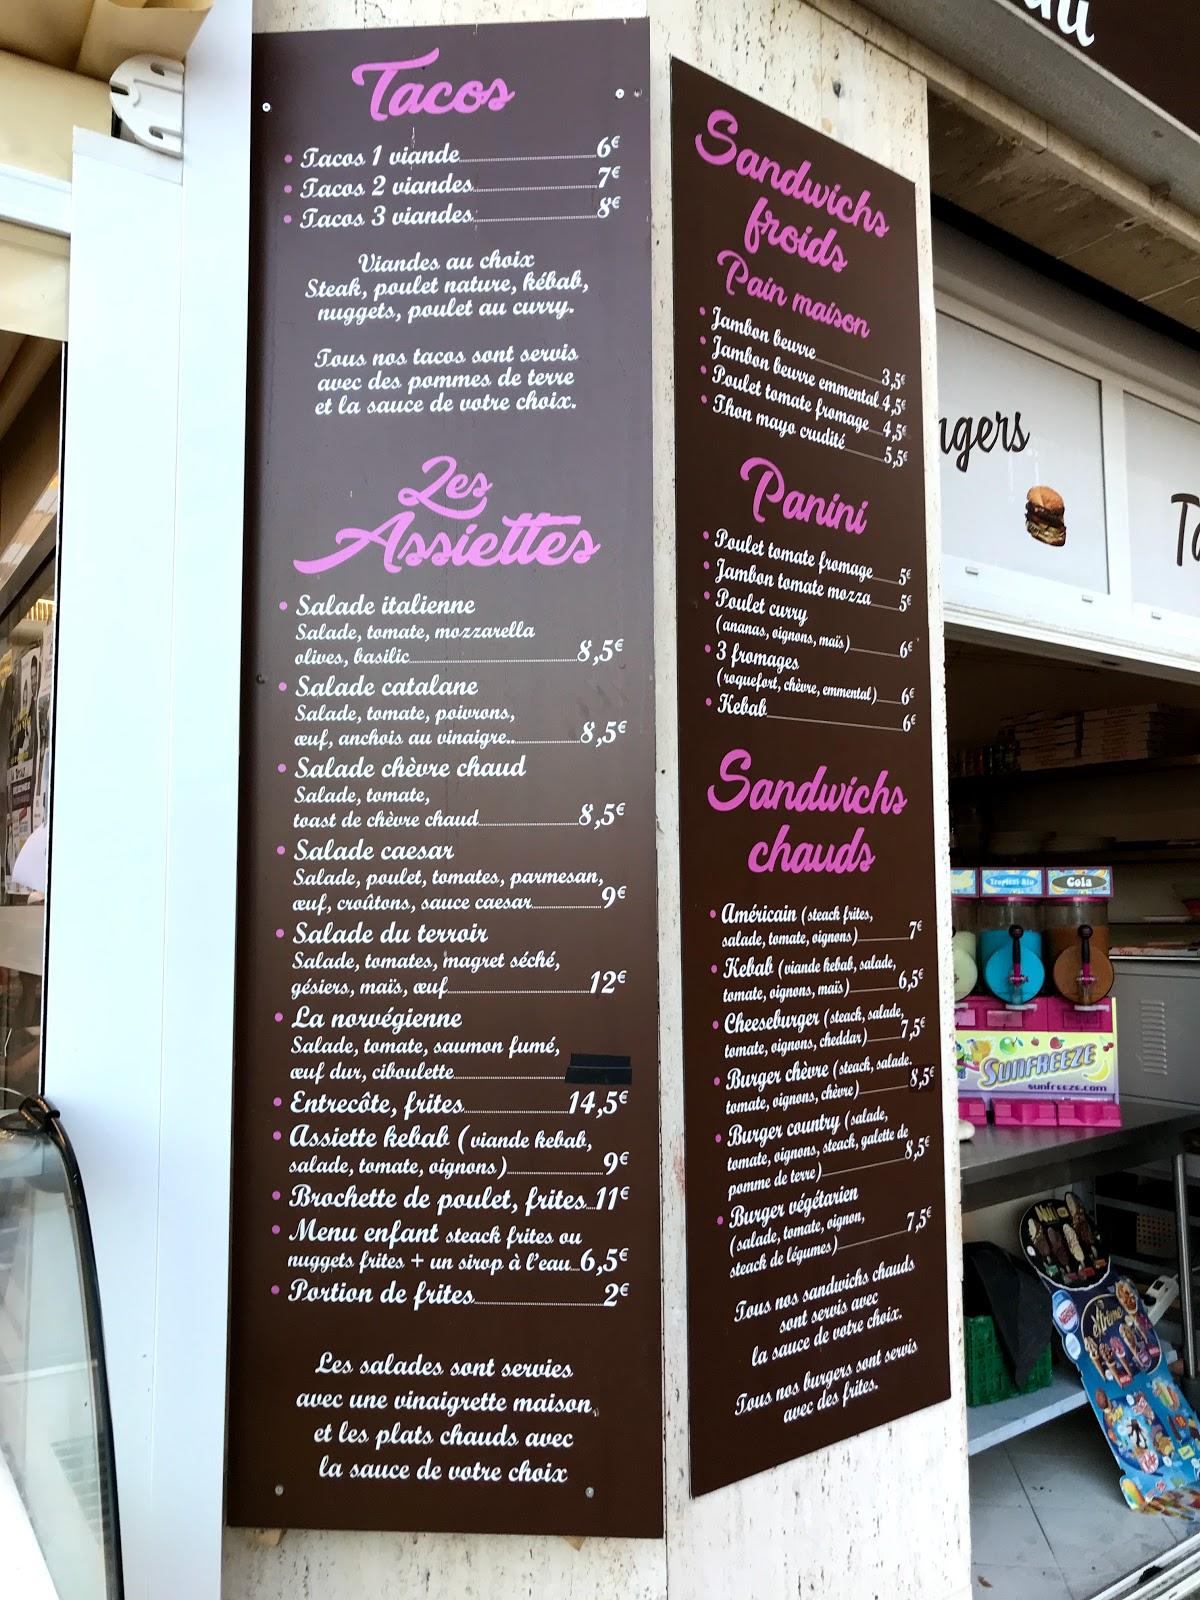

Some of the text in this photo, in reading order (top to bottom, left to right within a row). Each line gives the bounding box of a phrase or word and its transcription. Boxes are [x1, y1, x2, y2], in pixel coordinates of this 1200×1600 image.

[351, 48, 514, 121] Tacos
[300, 135, 621, 168] Tacos 1 viande 6€
[300, 165, 621, 198] Tacos 2 viandes 7€
[695, 110, 888, 236] Sandwichs
[299, 196, 621, 228] Tacos 3 viandes 8€
[744, 197, 848, 272] froids
[358, 248, 535, 273] Viandes au choix
[304, 269, 589, 301] Steak, poulet nature, kébab,
[717, 250, 869, 336] Pain maison
[317, 297, 574, 326] nuggets, poulet au curry.
[314, 343, 577, 368] Tous nos tacos sont servis
[710, 305, 906, 391] Jambon beurre 3,5€
[317, 366, 575, 394] avec des pommes de terre
[711, 334, 907, 416] Jambon beurre emmental 4,5€
[314, 389, 577, 415] et la sauce de votre choix.
[711, 364, 907, 442] Poulet tomate fromage 4,5€
[712, 393, 909, 468] Thon mayo crudité 5,5€
[399, 456, 491, 520] Les
[740, 457, 869, 533] Panini
[294, 511, 599, 573] Assiettes
[714, 527, 912, 585] Poulet tomate fromage 5€
[714, 557, 913, 612] Jambon tomate mozza 5€
[295, 592, 476, 616] Salade italienne
[714, 588, 808, 626] Poulet curry
[295, 620, 535, 642] Salade, tomate, mozzarella
[294, 638, 624, 667] olives, basilic 8,5€
[715, 639, 800, 674] 3 fromages
[295, 673, 479, 696] Salade catalane
[716, 693, 917, 732] Kebab 6€
[294, 754, 527, 778] Salade chèvre chaud
[707, 748, 908, 814] Sandwichs
[293, 802, 626, 830] toast de chèvre chaud 8,5€
[293, 838, 455, 861] Salade caesar
[747, 823, 875, 873] chauds
[1066, 876, 1093, 888] Cola
[292, 921, 489, 944] Salade du terroir
[721, 929, 766, 949] salade,
[768, 930, 810, 947] tomate,
[909, 919, 923, 940] 7€
[291, 978, 355, 1000] gésiers,
[360, 978, 408, 997] maïs,
[590, 970, 628, 993] 12€
[722, 986, 767, 1003] tomate,
[769, 984, 816, 1003] oignons,
[898, 967, 924, 992] 6,5€
[292, 1005, 463, 1035] La norvégienne
[329, 1061, 367, 1082] dur,
[371, 1061, 454, 1080] ciboulette
[982, 1043, 1097, 1087] SUNFREEZE
[1027, 1082, 1107, 1092] sunfreeze.com
[289, 1090, 629, 1120] Entrecôte, frites 14,5€
[288, 1183, 631, 1216] Brochette de poulet, frites 11€
[728, 1185, 859, 1229] Burger végétarien
[287, 1278, 630, 1311] Portion de frites 2€
[733, 1253, 915, 1322] Tous nos sandwichs chauds
[734, 1337, 919, 1416] Tous nos burgers sont servis
